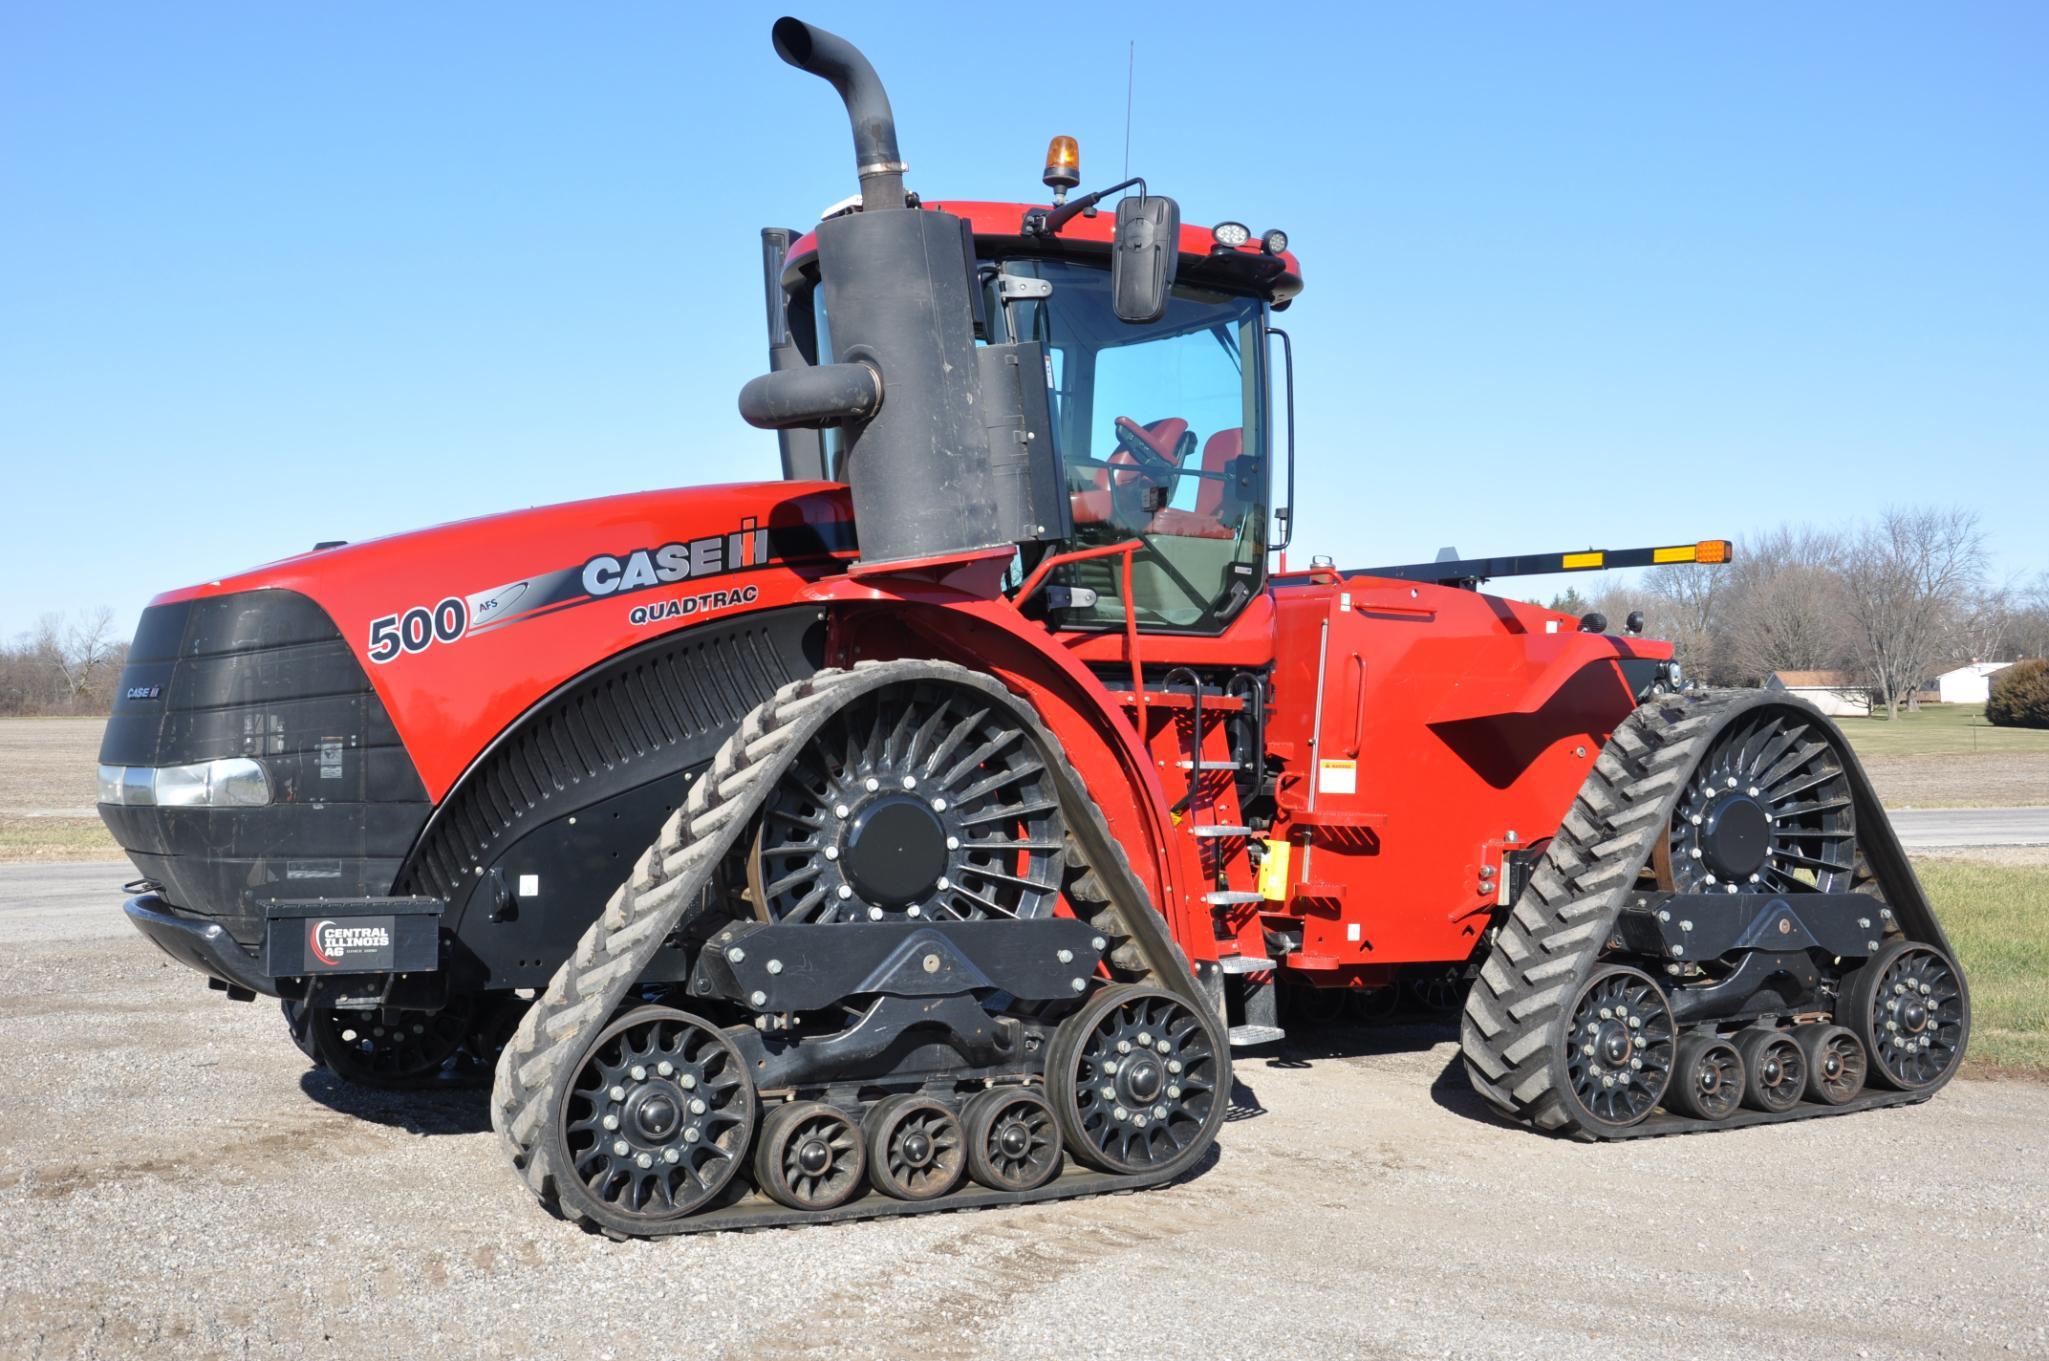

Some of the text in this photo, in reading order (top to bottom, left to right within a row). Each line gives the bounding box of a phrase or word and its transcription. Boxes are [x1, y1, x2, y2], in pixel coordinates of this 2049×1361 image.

[582, 536, 722, 596] CASE
[479, 598, 498, 613] AFS
[629, 585, 758, 625] QUADTRAC
[369, 597, 468, 664] 500
[127, 687, 150, 698] CASE
[324, 927, 389, 938] CENTRAL
[324, 936, 389, 948] ILLINOIS
[324, 946, 345, 957] AG
